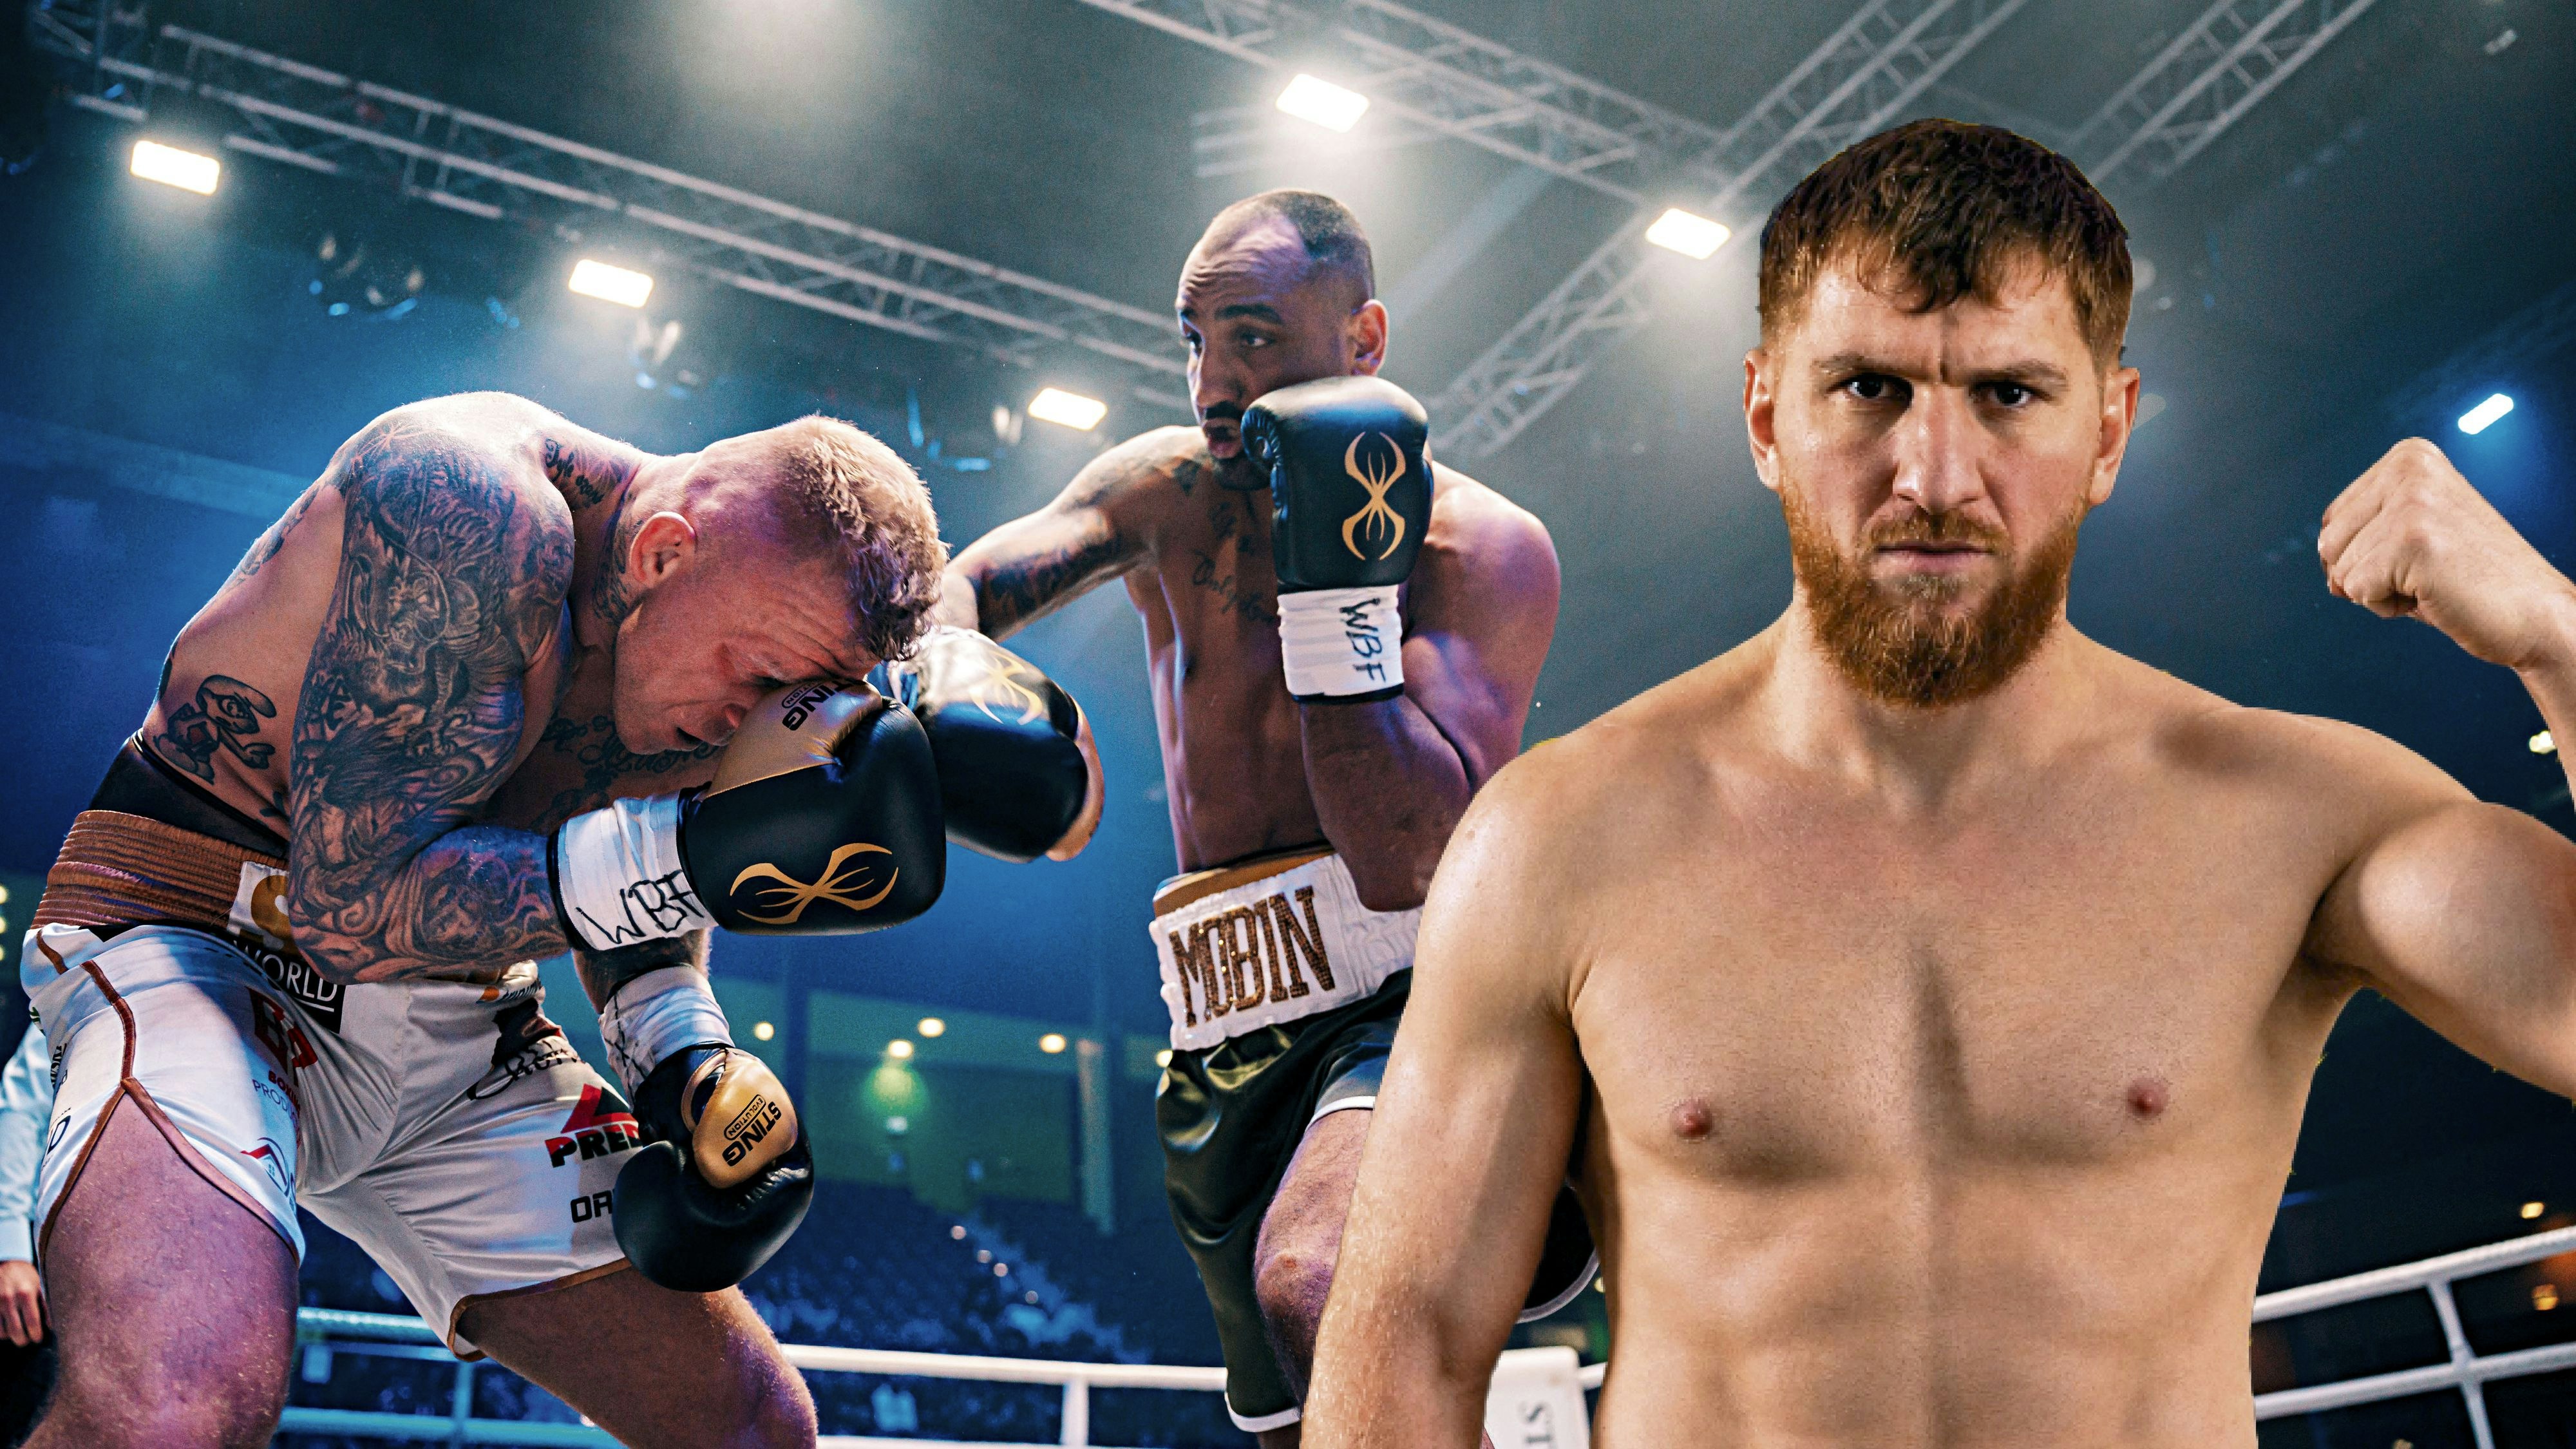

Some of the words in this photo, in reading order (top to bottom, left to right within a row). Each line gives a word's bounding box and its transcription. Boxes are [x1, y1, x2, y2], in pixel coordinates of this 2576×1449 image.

[1339, 597, 1387, 684] WBF
[782, 679, 860, 730] TING
[576, 869, 704, 944] WBF
[1168, 886, 1335, 1027] MOBIN
[722, 1101, 782, 1167] STING
[728, 1097, 764, 1136] EVOLUTION
